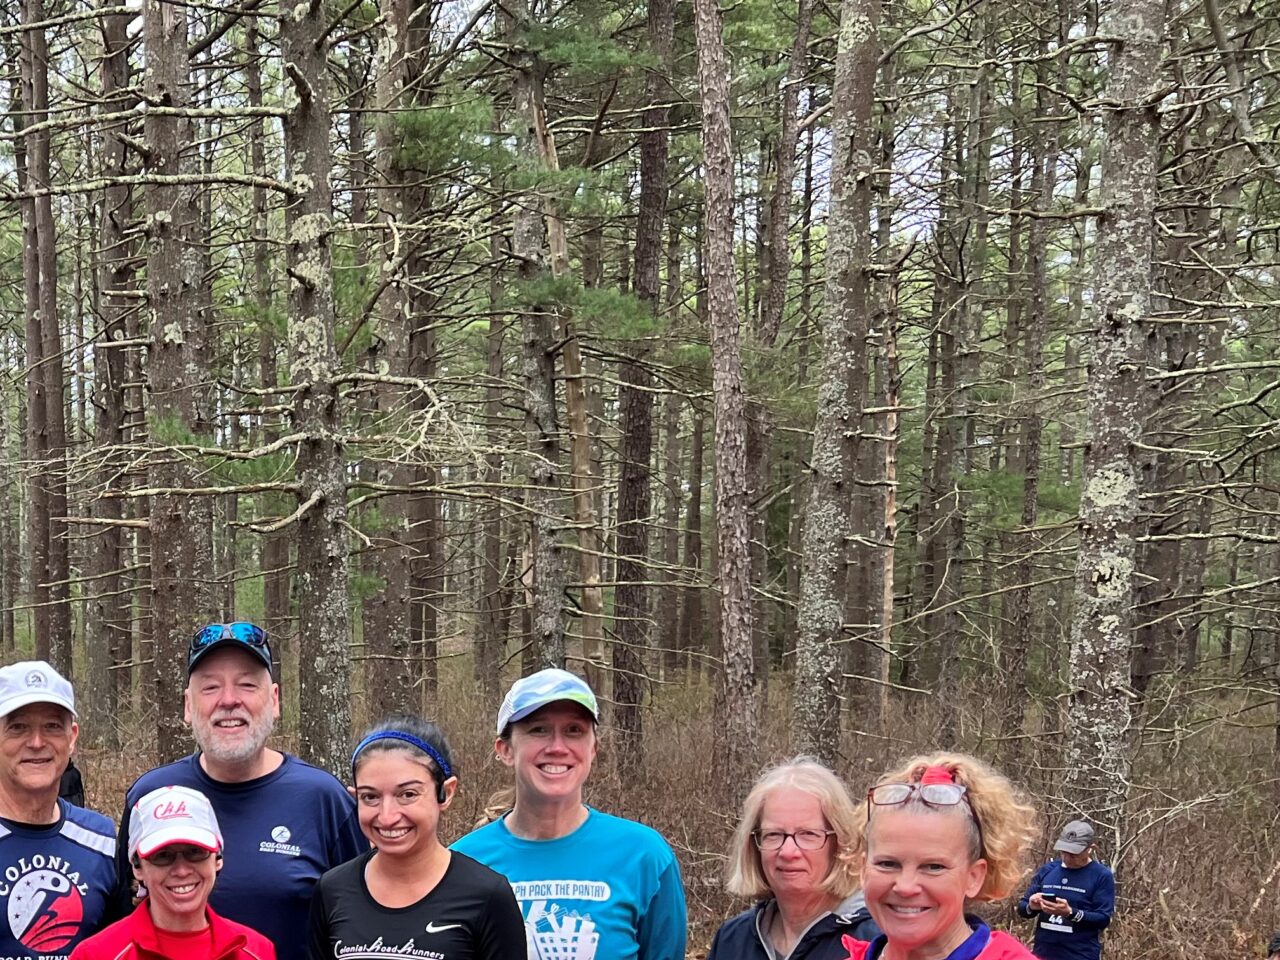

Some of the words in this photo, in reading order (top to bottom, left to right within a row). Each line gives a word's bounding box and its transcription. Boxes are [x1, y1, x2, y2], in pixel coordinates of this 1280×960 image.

[260, 841, 301, 852] COLONIAL
[529, 884, 552, 897] PACK
[555, 883, 570, 896] THE
[573, 884, 605, 898] PANTRY
[1048, 914, 1063, 925] 44
[334, 940, 367, 959] Colonial
